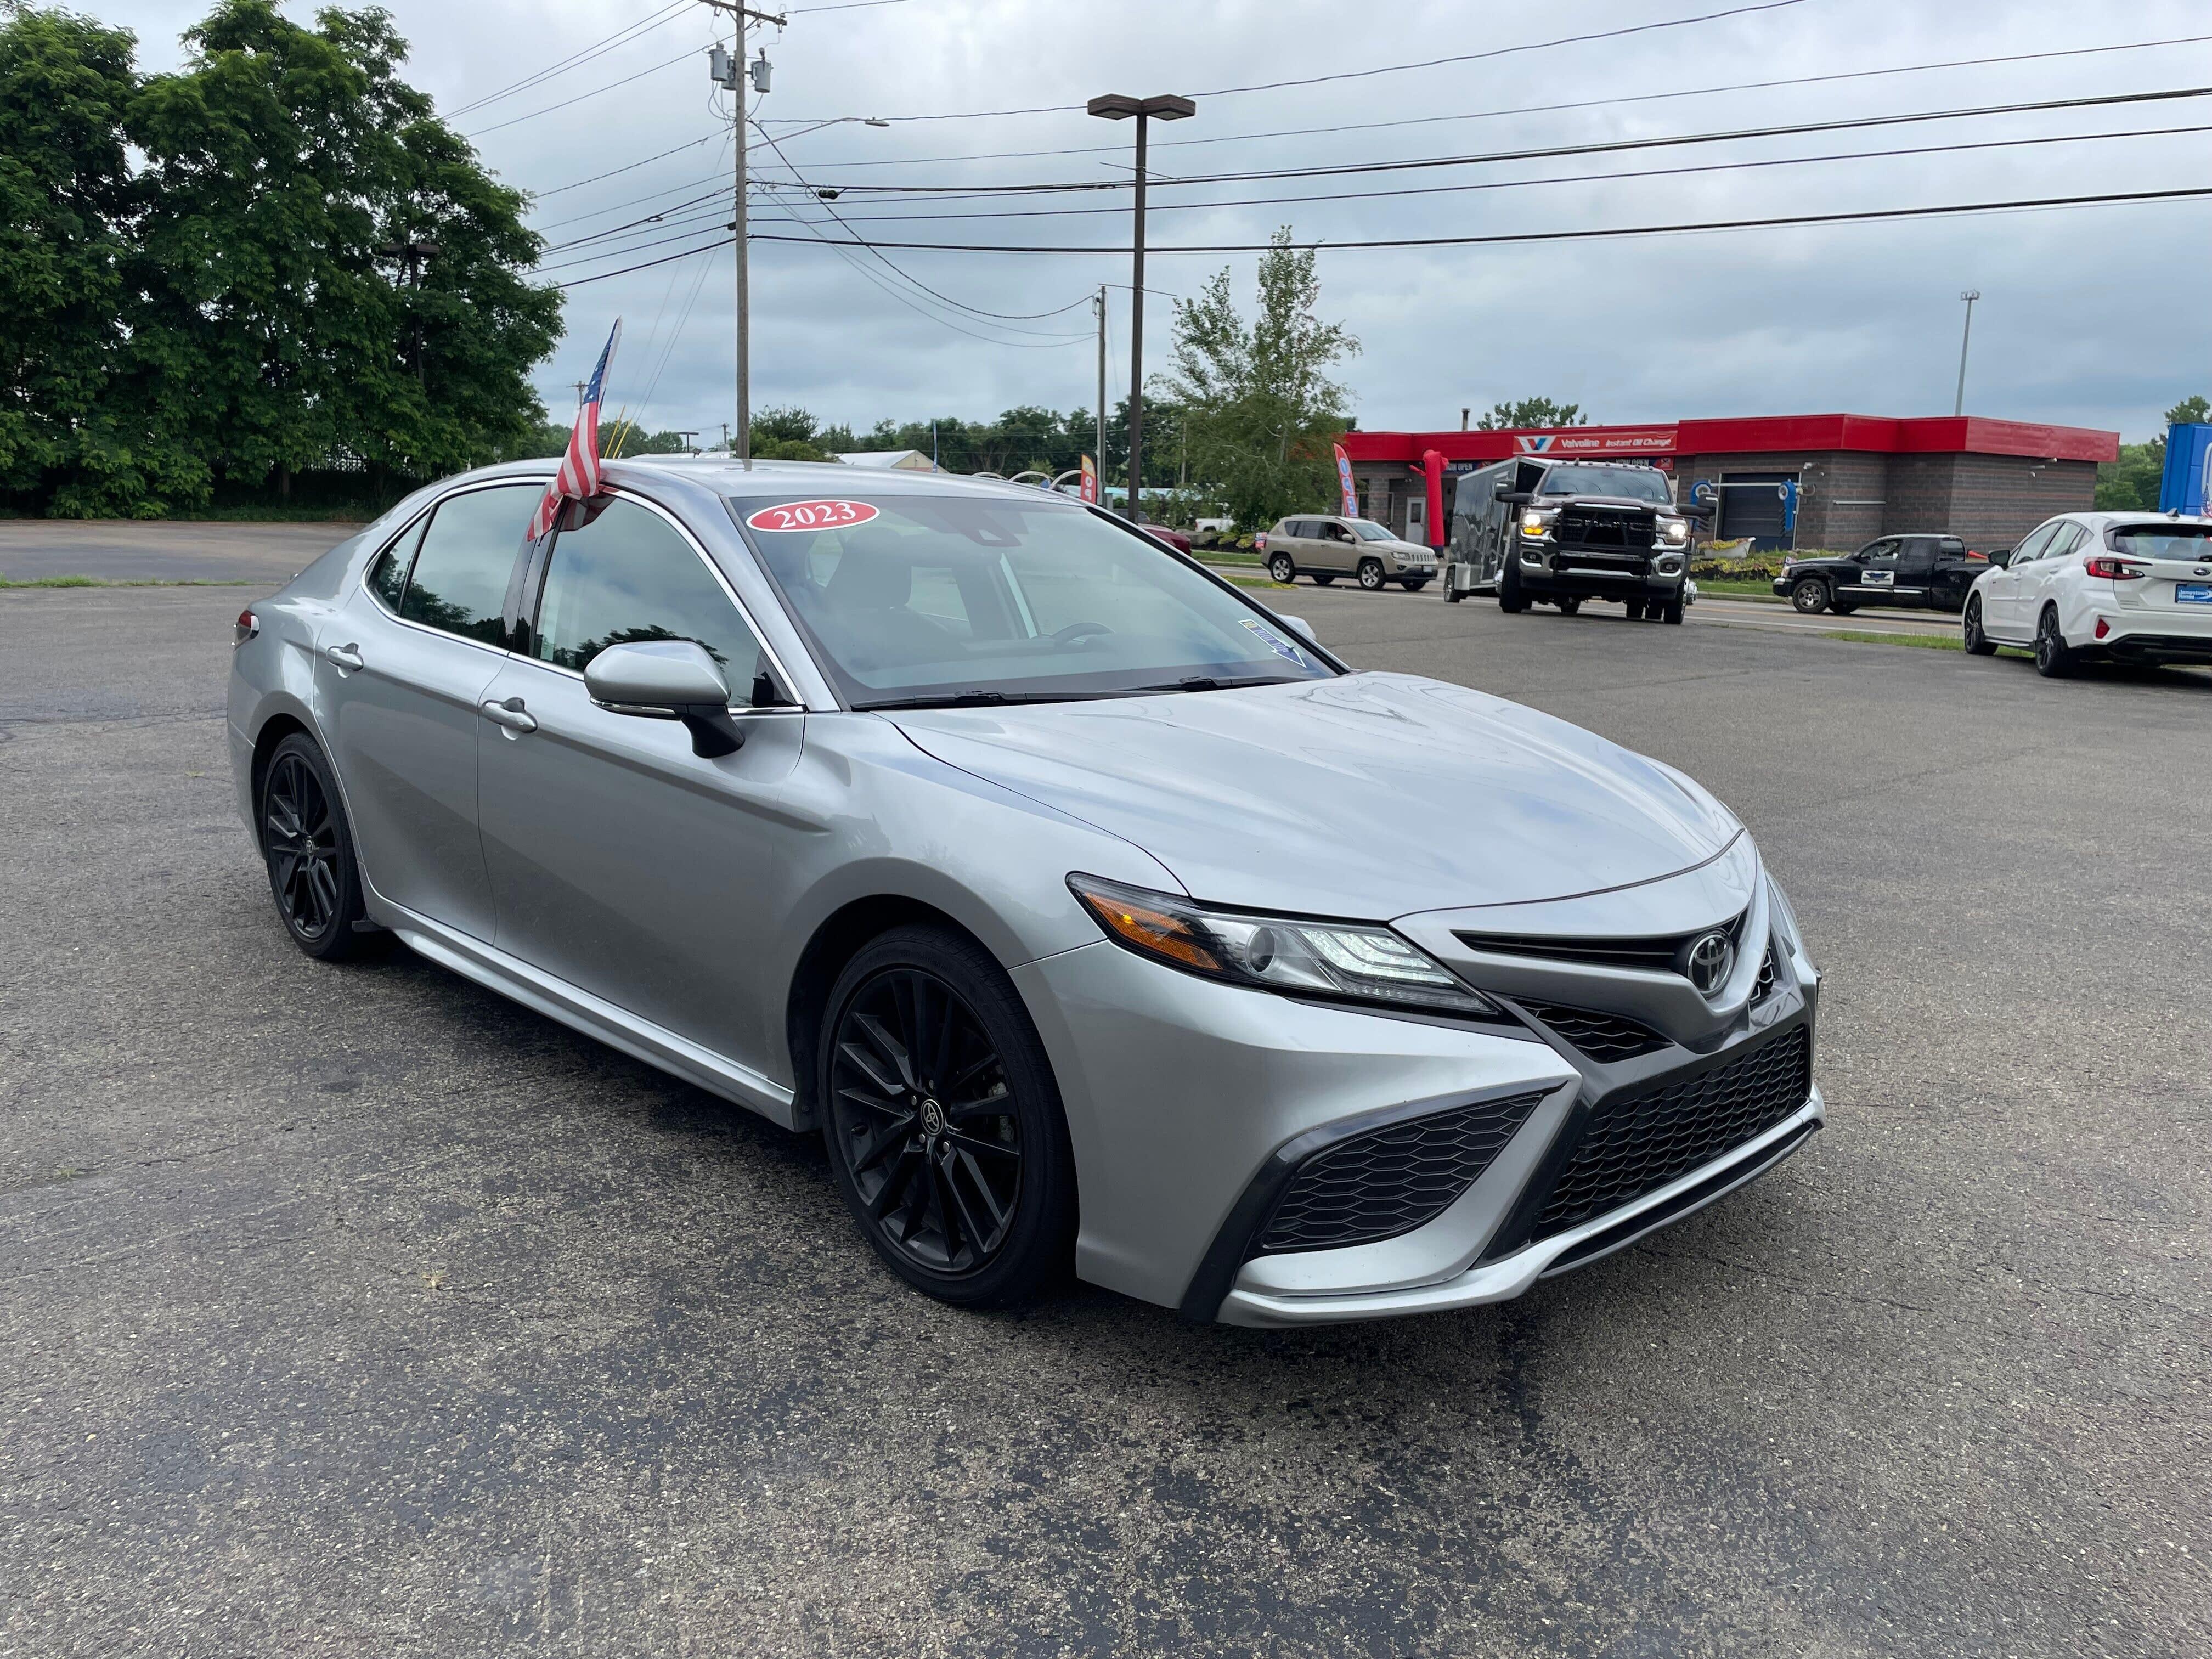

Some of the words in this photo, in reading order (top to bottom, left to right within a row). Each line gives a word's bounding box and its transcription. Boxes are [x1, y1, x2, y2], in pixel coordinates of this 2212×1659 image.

[1561, 439, 1600, 448] Valvoline
[1643, 438, 1671, 447] Change
[1632, 459, 1649, 467] OPEN
[773, 503, 856, 528] 2023
